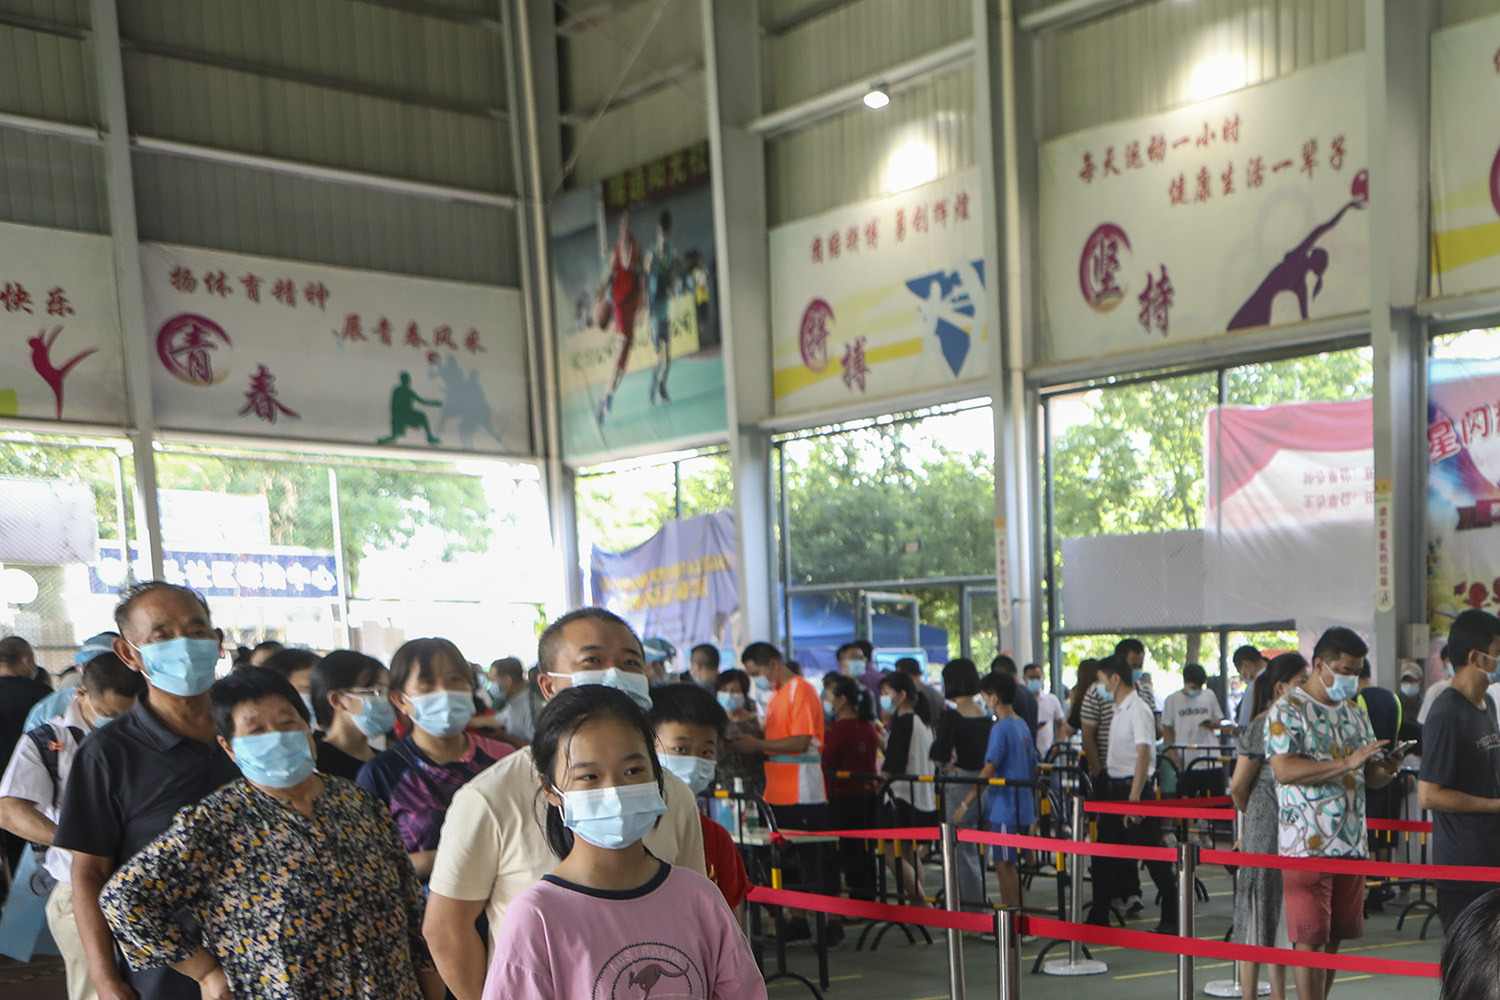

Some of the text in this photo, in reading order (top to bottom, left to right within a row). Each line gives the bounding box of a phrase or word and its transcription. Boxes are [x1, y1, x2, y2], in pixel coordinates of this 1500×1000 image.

[1078, 113, 1242, 183] 每天运动一小时
[169, 266, 331, 312] 扬体育精神
